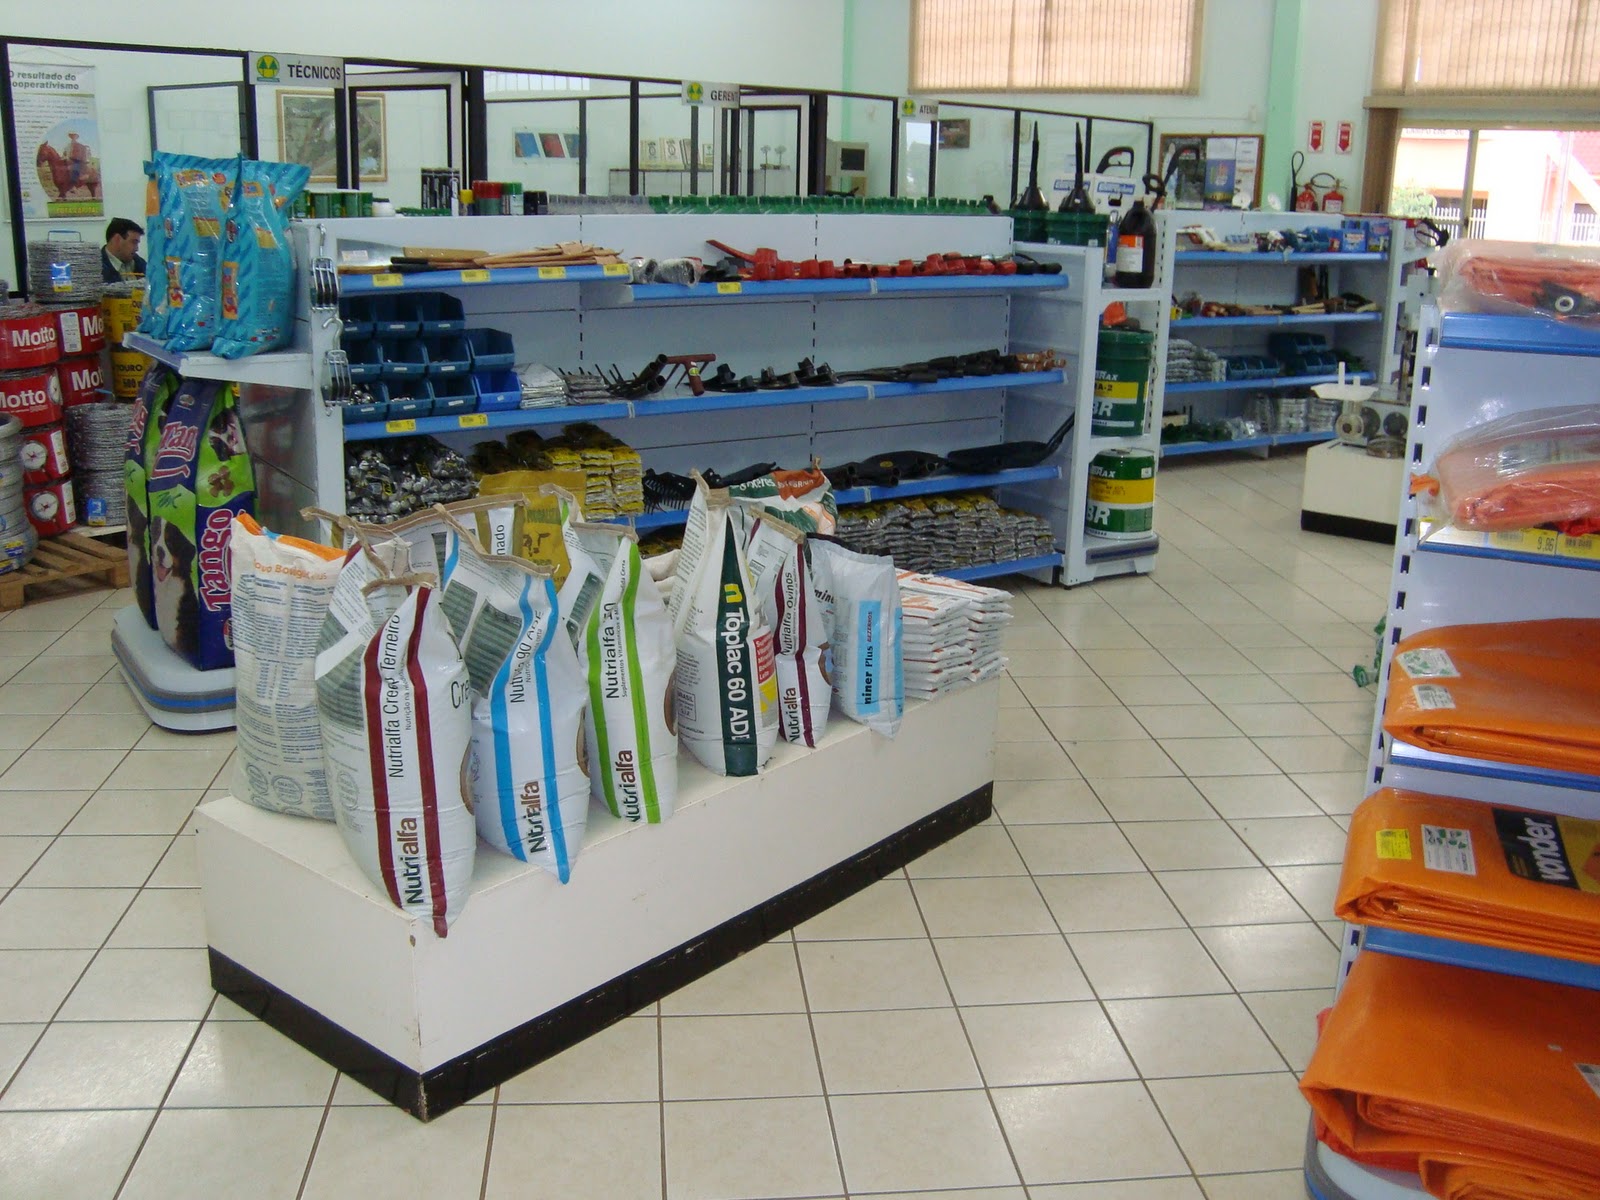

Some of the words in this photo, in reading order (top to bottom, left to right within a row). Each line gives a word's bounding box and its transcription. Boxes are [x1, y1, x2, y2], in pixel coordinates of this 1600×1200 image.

[12, 81, 80, 90] ooperativismo
[17, 72, 63, 81] resultado
[64, 73, 77, 81] do
[287, 60, 341, 80] TÉCNICOS
[12, 326, 56, 347] Motto
[71, 367, 104, 391] Mot
[785, 572, 794, 609] Ovinos
[380, 614, 401, 671] Terneiro
[721, 607, 745, 674] Toplac
[780, 612, 793, 656] Nutrialfa
[602, 627, 620, 698] Nutrialfa
[865, 646, 873, 667] Plus
[450, 680, 470, 709] Cre
[619, 659, 628, 697] Suplementos
[727, 677, 746, 702] 60
[784, 687, 800, 742] Nutrialfa
[385, 720, 404, 778] Nutrialfa
[615, 750, 640, 822] Nutrialfa
[401, 817, 424, 906] Nutrialfa
[1517, 817, 1570, 880] vonder
